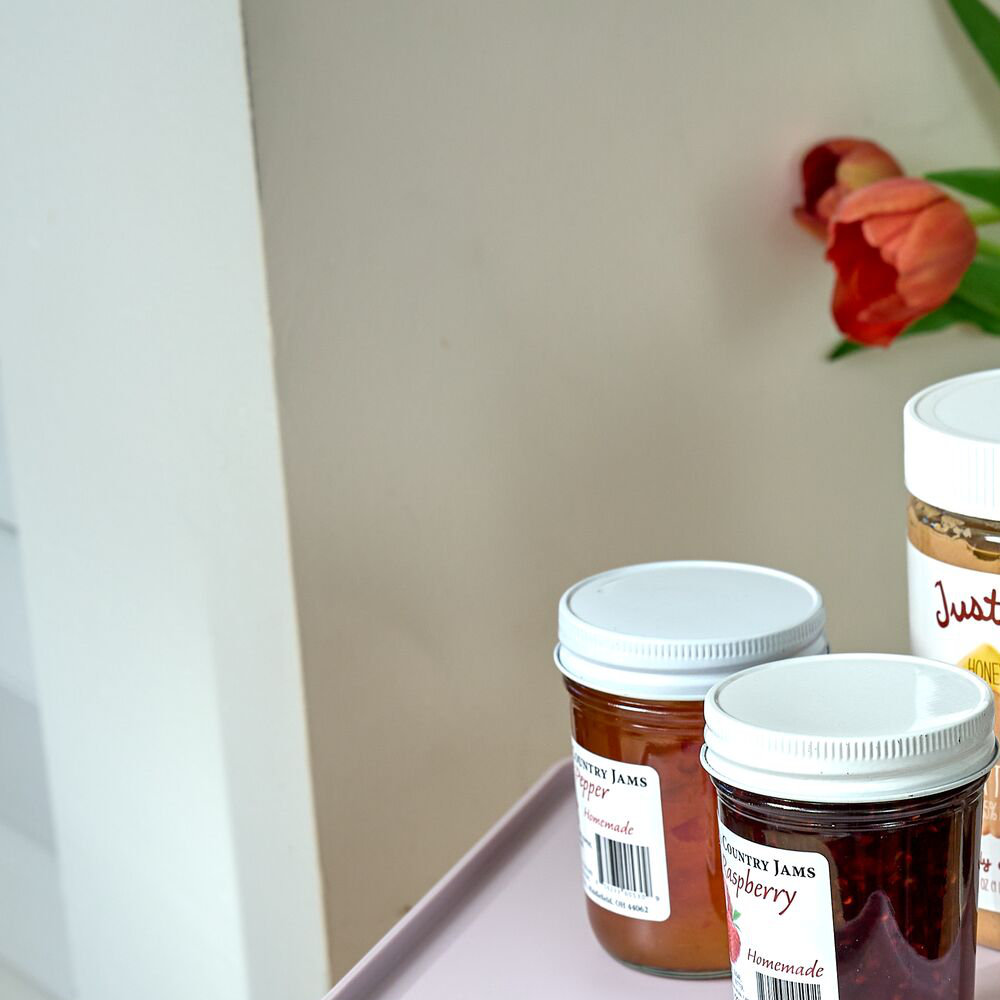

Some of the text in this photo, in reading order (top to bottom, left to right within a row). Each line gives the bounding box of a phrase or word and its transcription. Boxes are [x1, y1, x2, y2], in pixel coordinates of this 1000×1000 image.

[612, 769, 648, 788] JAMS
[584, 807, 634, 836] Homemade
[722, 835, 816, 878] COUNTRY JAMS
[747, 948, 824, 978] Homemade
